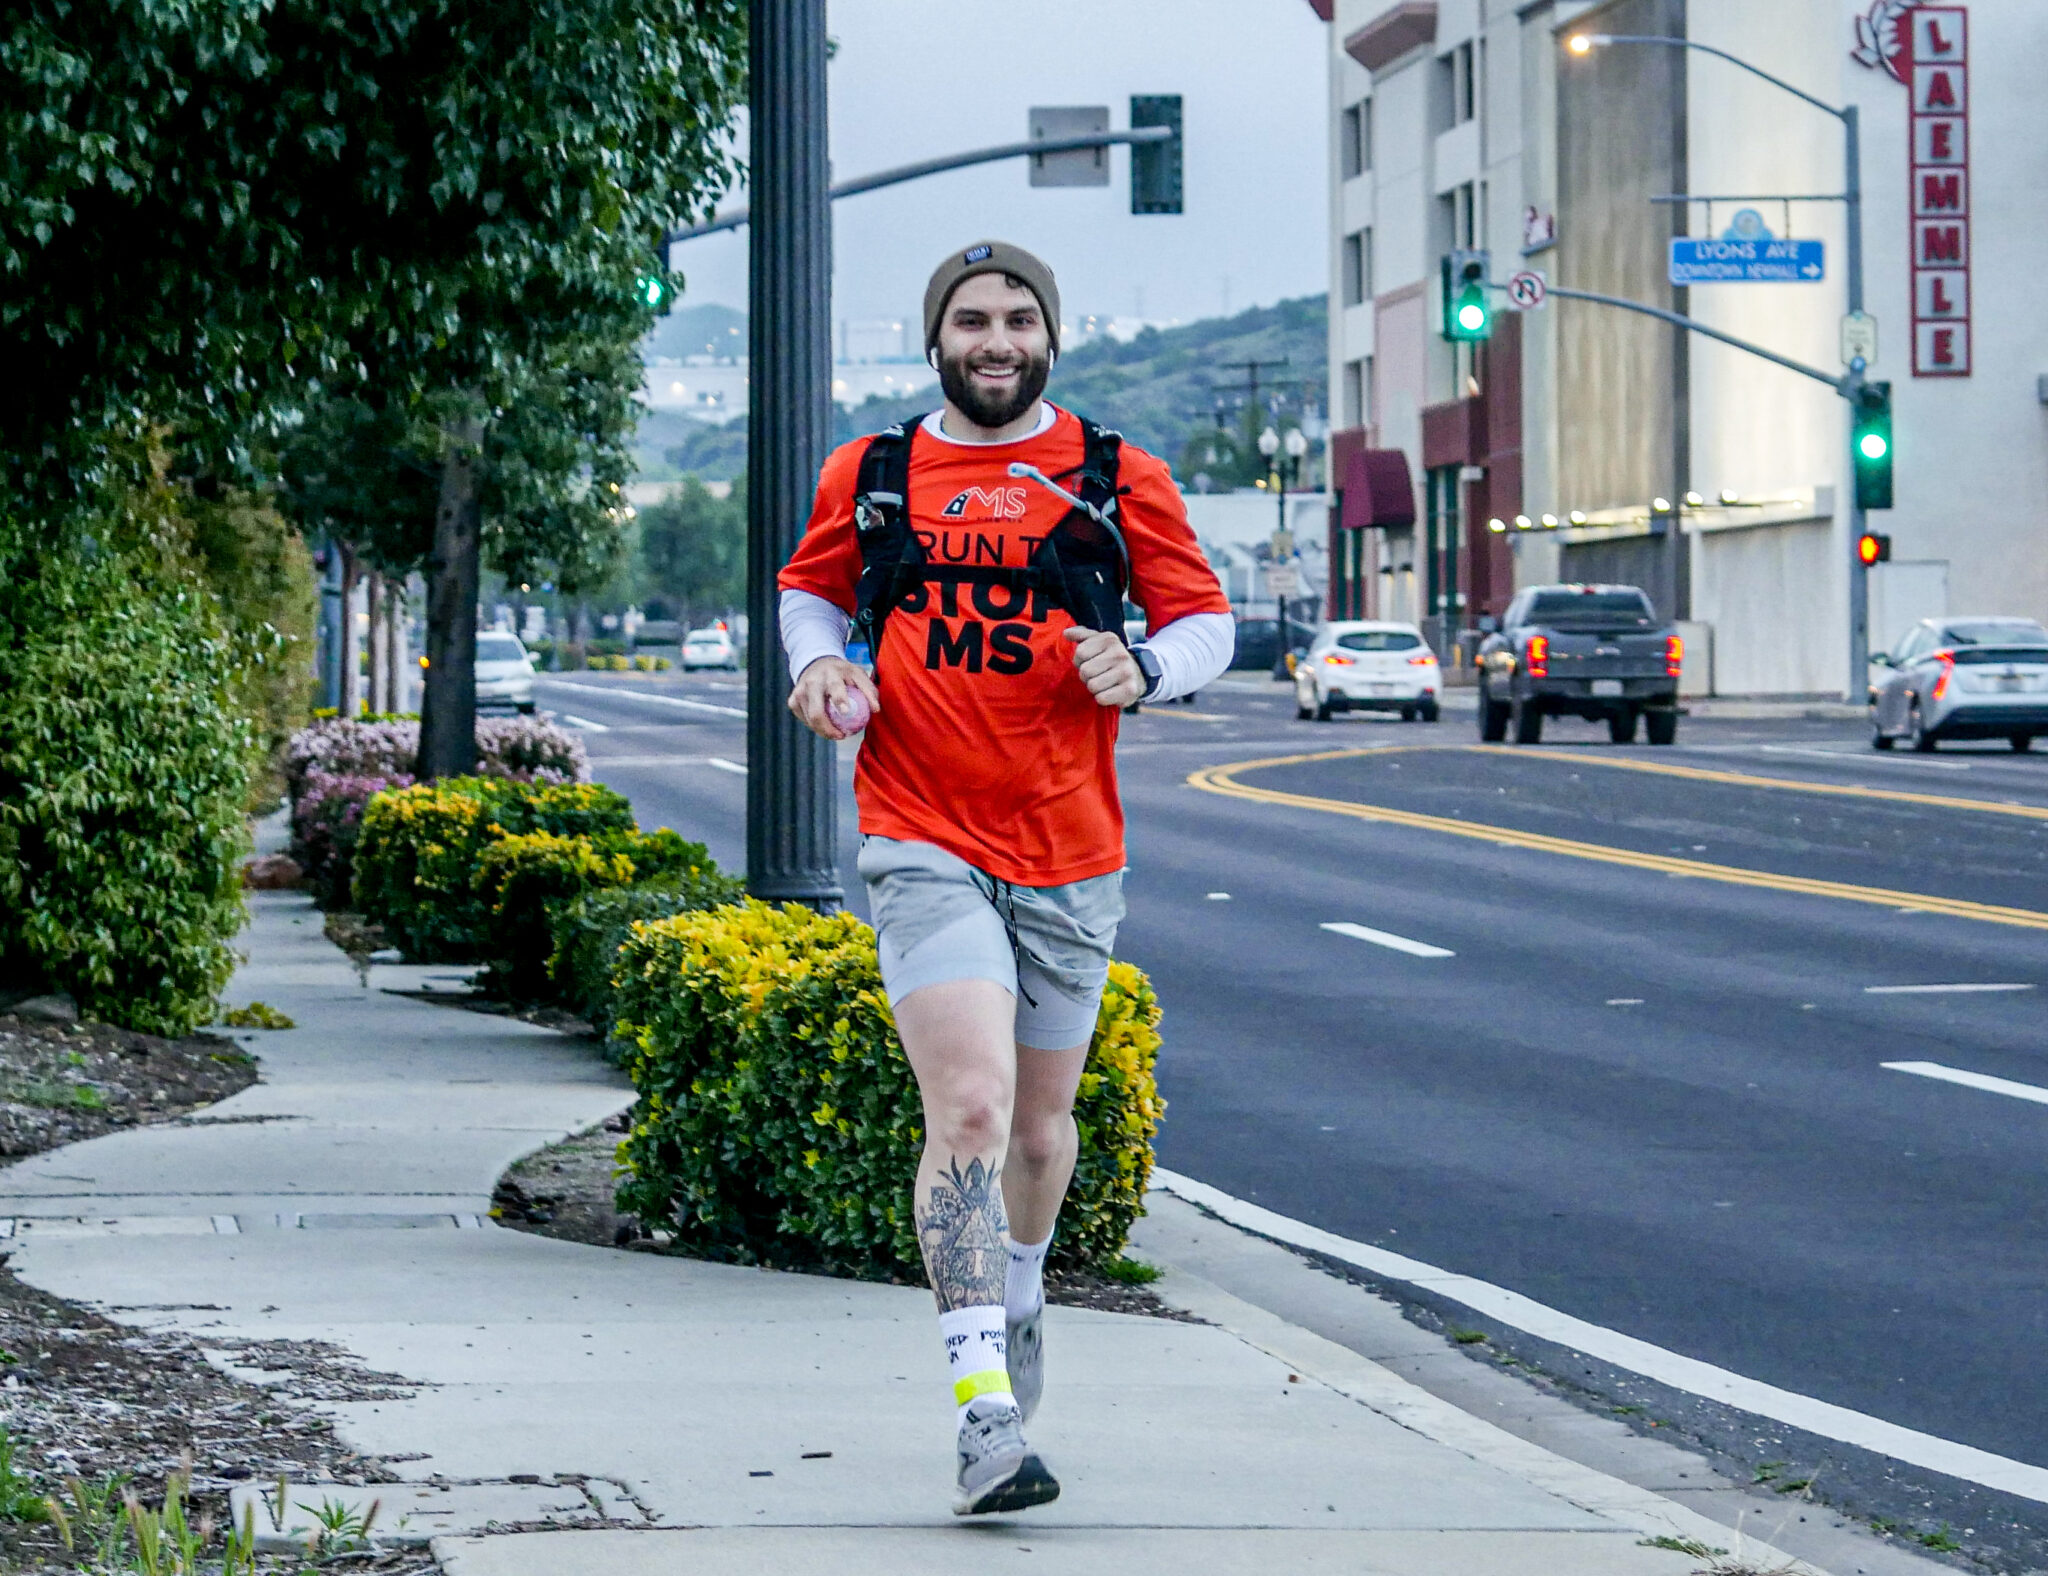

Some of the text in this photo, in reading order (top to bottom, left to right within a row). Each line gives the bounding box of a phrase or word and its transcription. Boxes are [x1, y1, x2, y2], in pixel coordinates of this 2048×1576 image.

[1924, 19, 1960, 366] LAEMMLE
[1696, 242, 1798, 259] LYONS AVE
[914, 531, 1044, 566] RUN T
[926, 618, 1033, 675] MS
